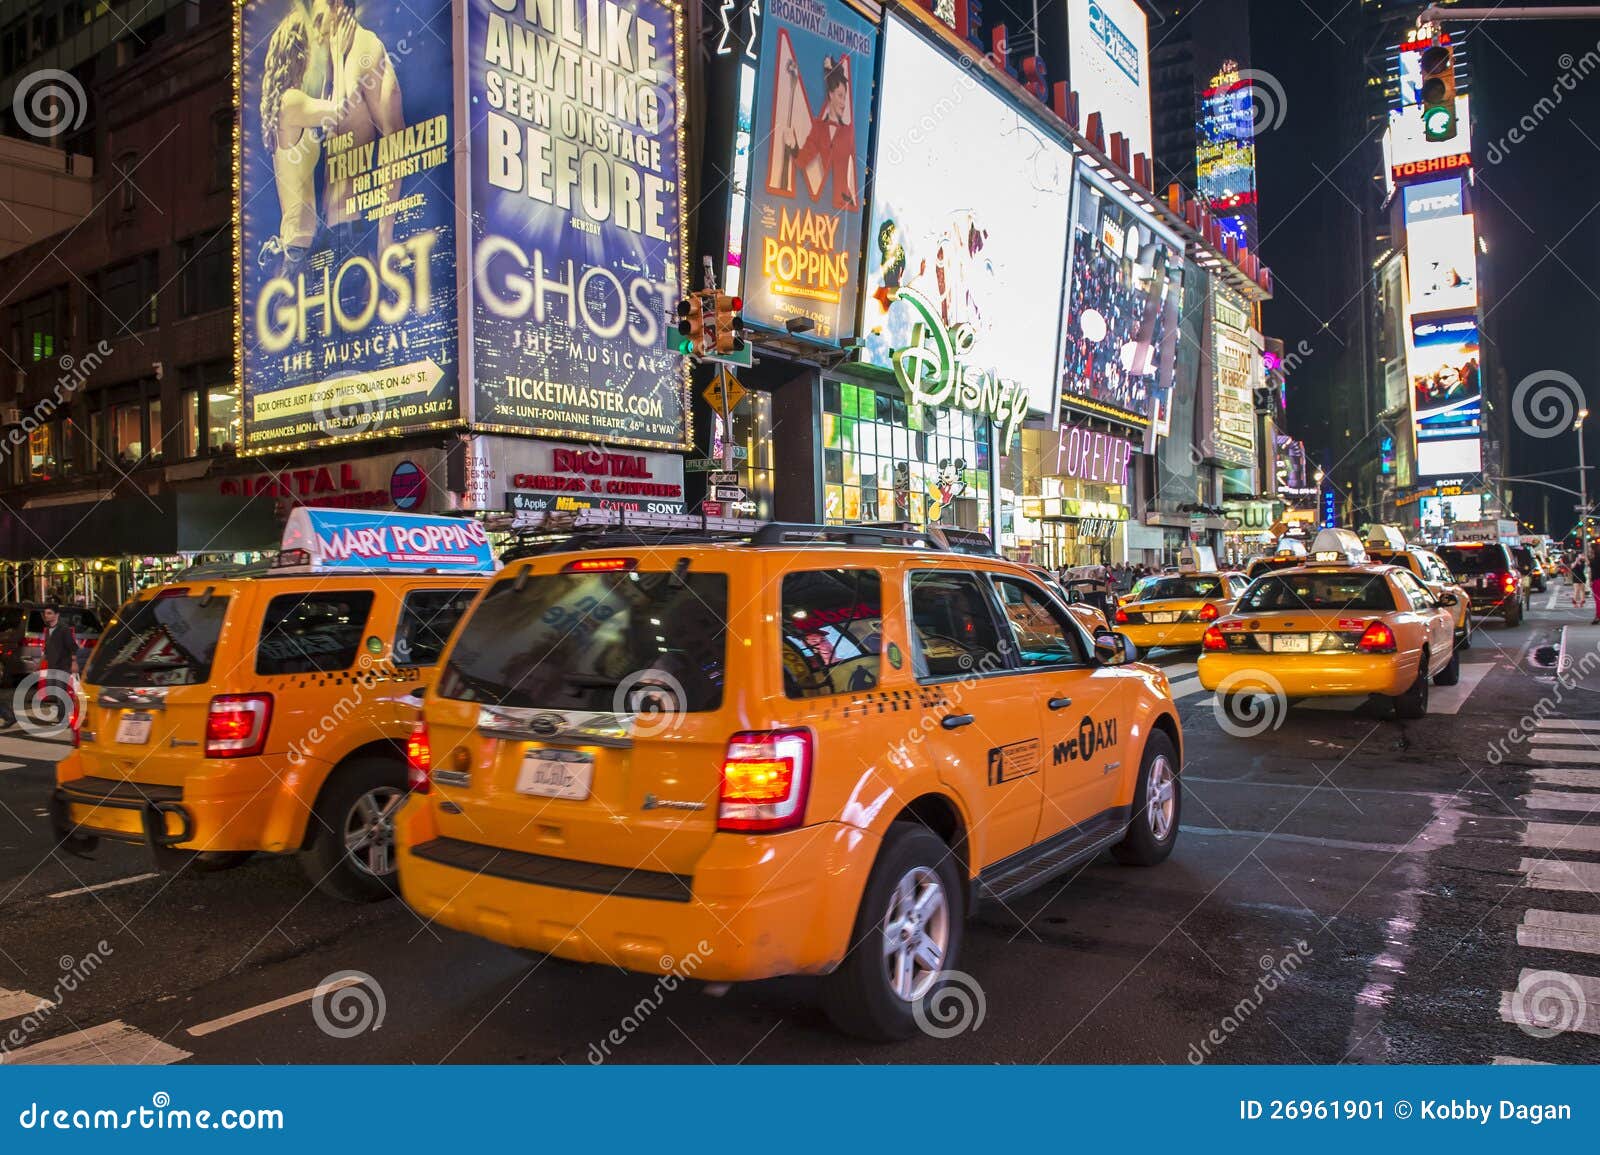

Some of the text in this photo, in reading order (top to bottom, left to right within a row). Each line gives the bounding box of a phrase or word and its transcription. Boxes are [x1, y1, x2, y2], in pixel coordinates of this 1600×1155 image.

[494, 0, 658, 83] NLIKE
[827, 22, 845, 43] AND
[484, 11, 659, 135] ANYTHING
[332, 131, 354, 153] WAS
[486, 70, 662, 173] SEEN ONSTAGE
[327, 114, 448, 185] TRULY AMAZED
[352, 145, 448, 194] FOR THE FIRST TIME
[1393, 153, 1471, 177] TOSHIBA
[345, 197, 356, 216] IN
[779, 205, 841, 251] MARY
[764, 236, 849, 289] POPPINS
[256, 231, 438, 351] GHOST
[474, 234, 680, 347] GHOST
[283, 330, 409, 373] THE MUSICAL
[569, 342, 660, 374] MUSICAL
[257, 401, 270, 413] BOX
[271, 397, 291, 410] OFFICE
[292, 394, 307, 406] JUST
[308, 388, 334, 403] ACROSS
[336, 385, 354, 397] TIMES
[356, 379, 384, 393] SQUARE
[385, 377, 399, 389] ON
[505, 375, 664, 418] TICKETMASTER.COM
[516, 405, 590, 425] LUNT-FONTANNE
[249, 426, 296, 442] PERFORMANCES:
[296, 422, 312, 434] MON
[325, 417, 341, 429] TUES
[385, 410, 392, 420] AT
[400, 405, 417, 418] WED
[424, 401, 438, 414] SAT
[438, 402, 447, 411] AT
[447, 399, 453, 411] 2
[552, 448, 653, 478] DIGITAL
[1056, 424, 1132, 487] FOREVER
[220, 463, 361, 497] DIGITAL
[514, 473, 586, 492] CAMERAS
[524, 498, 547, 510] Apple
[600, 499, 640, 512] Canon
[647, 503, 683, 514] SONY
[315, 521, 488, 562] MARY POPPINS
[1053, 740, 1078, 766] NYC
